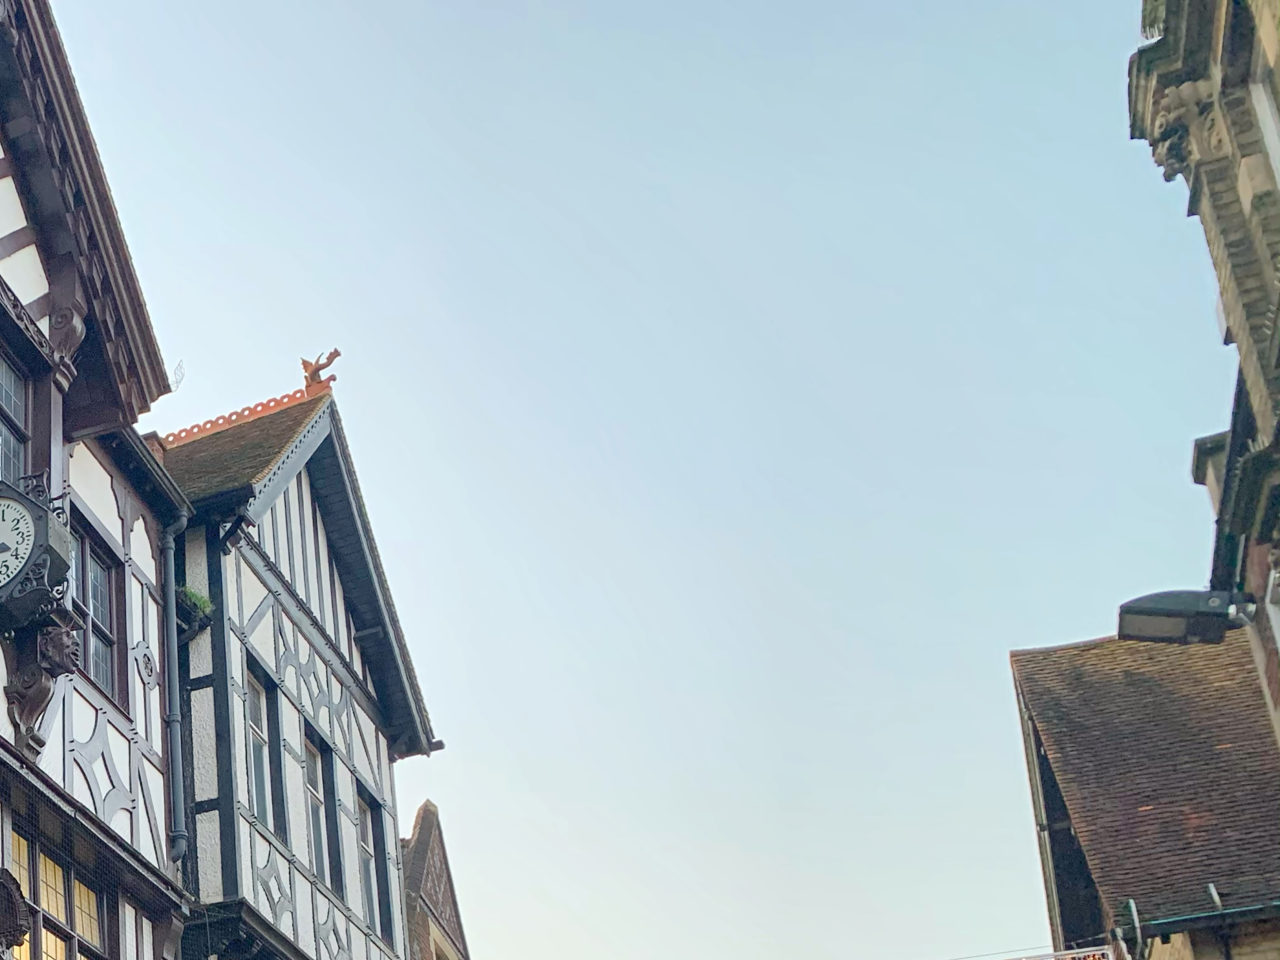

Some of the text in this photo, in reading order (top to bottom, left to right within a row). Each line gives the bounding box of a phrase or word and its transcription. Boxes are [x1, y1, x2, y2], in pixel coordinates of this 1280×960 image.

[1, 509, 6, 522] 1
[11, 518, 20, 532] 2
[16, 531, 25, 545] 3
[10, 547, 20, 560] 4
[0, 560, 10, 576] 5
